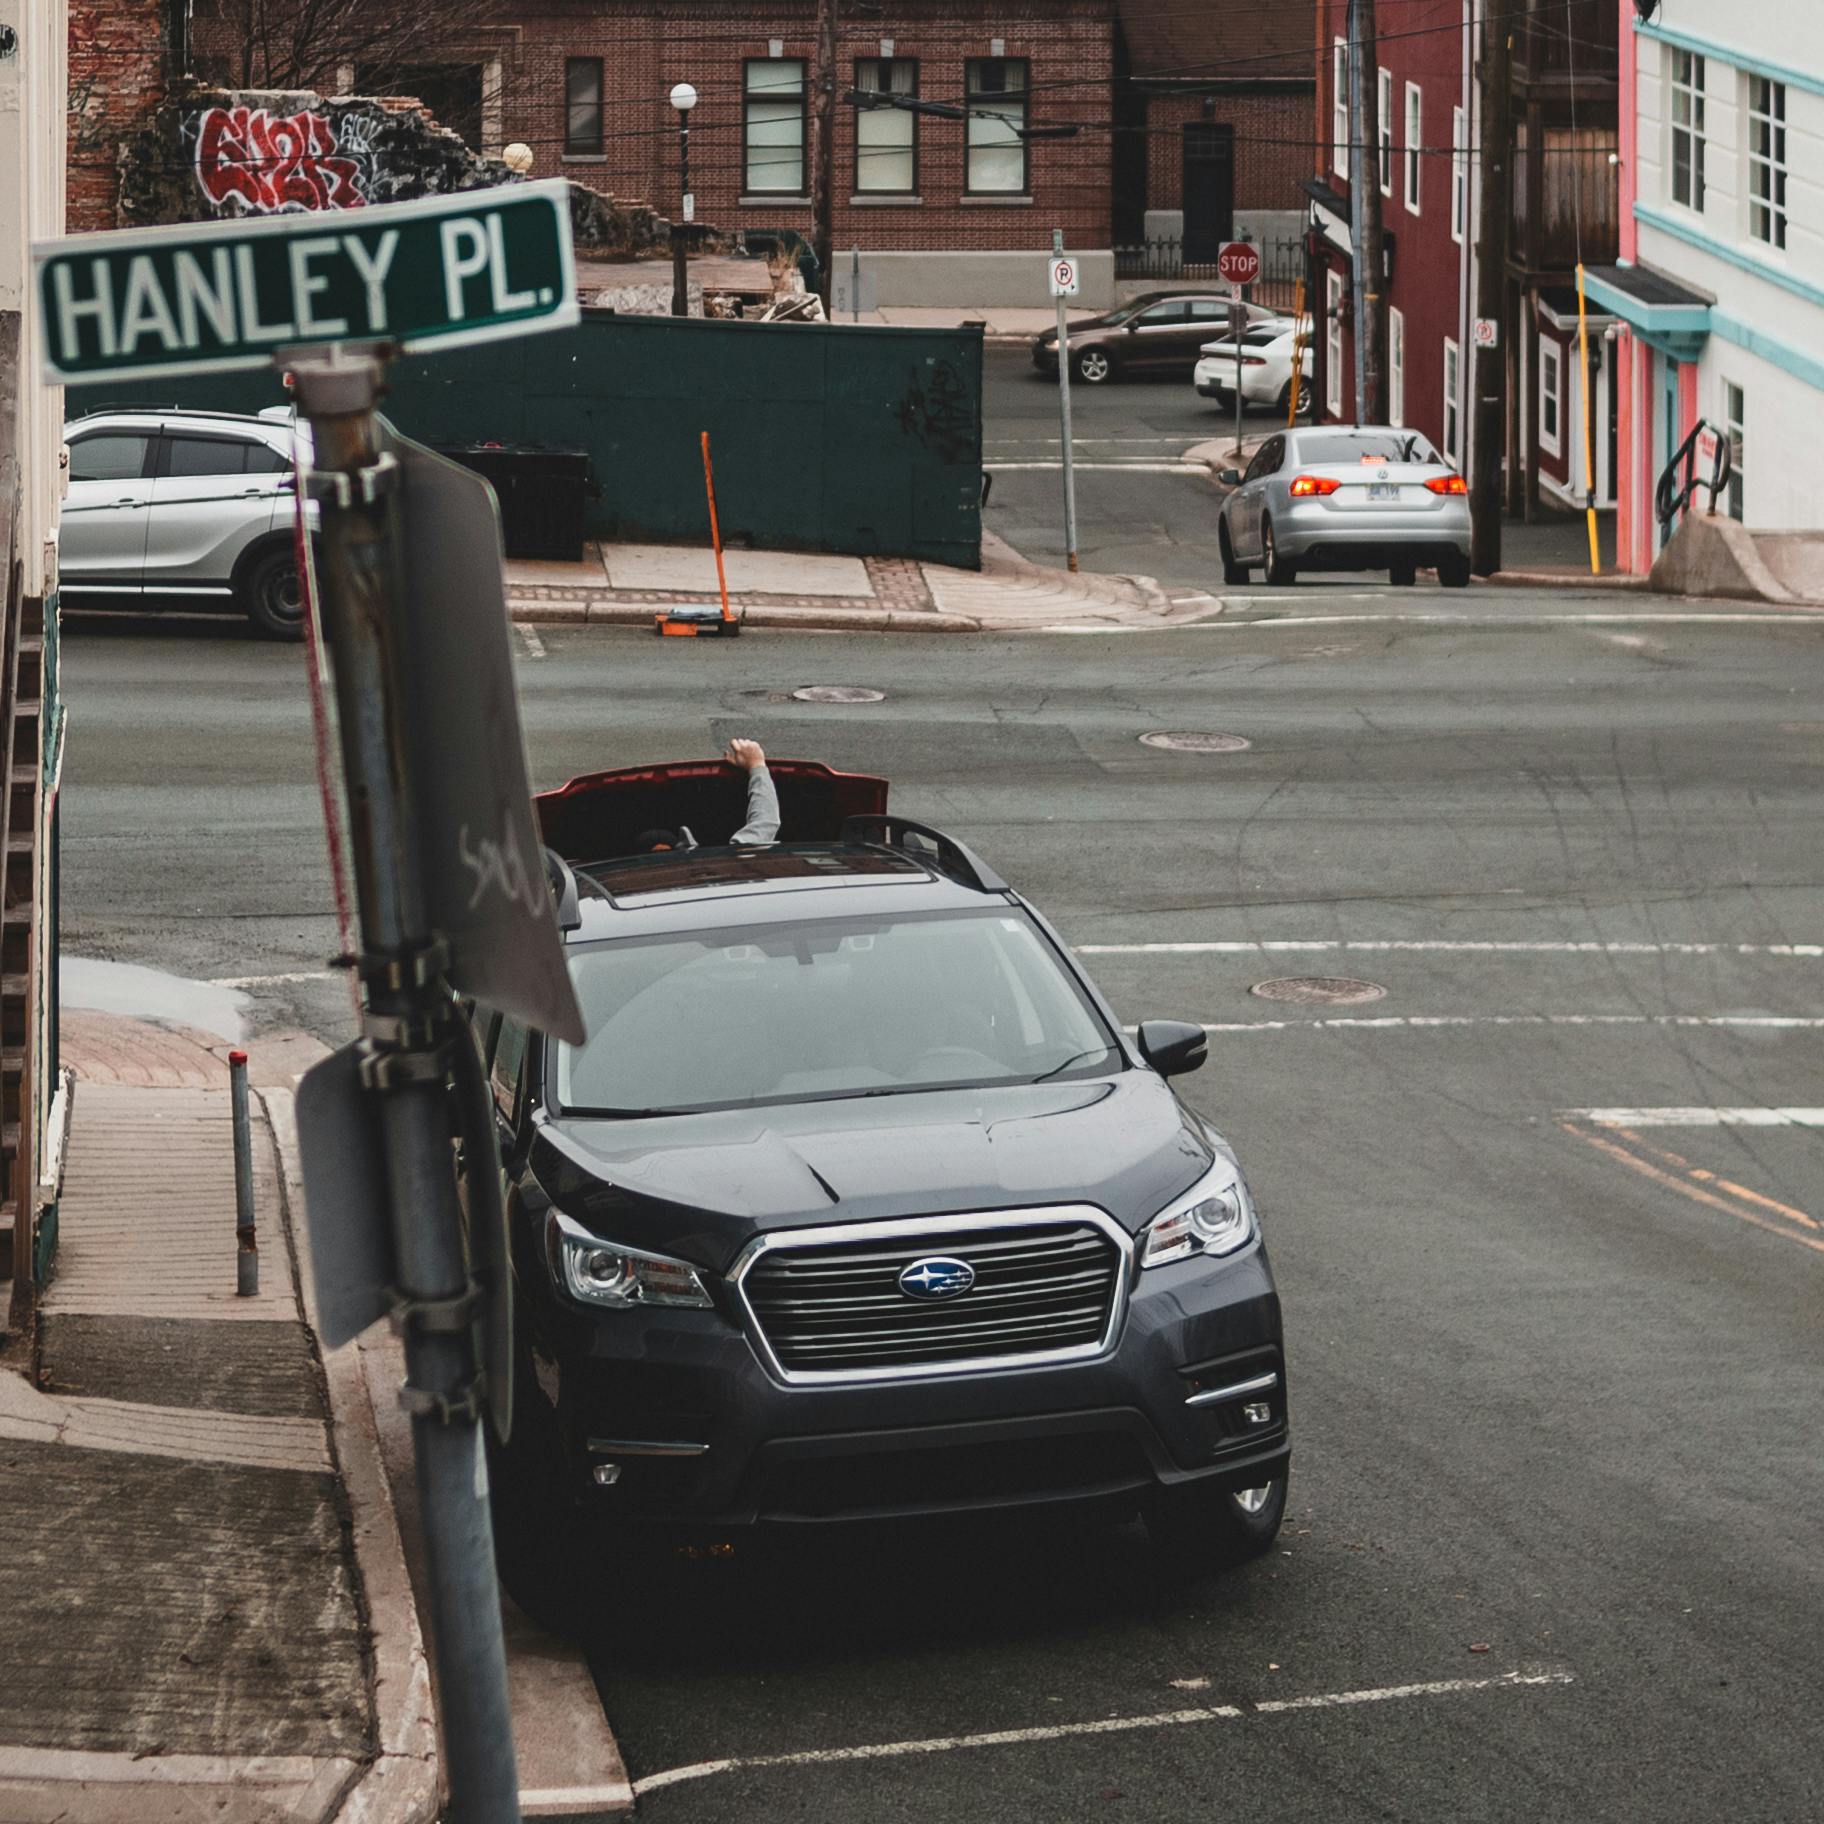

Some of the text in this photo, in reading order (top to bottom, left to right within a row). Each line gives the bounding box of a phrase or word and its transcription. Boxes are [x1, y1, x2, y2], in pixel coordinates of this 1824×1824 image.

[52, 212, 554, 359] HANLEY PL.
[1220, 255, 1257, 272] STOP
